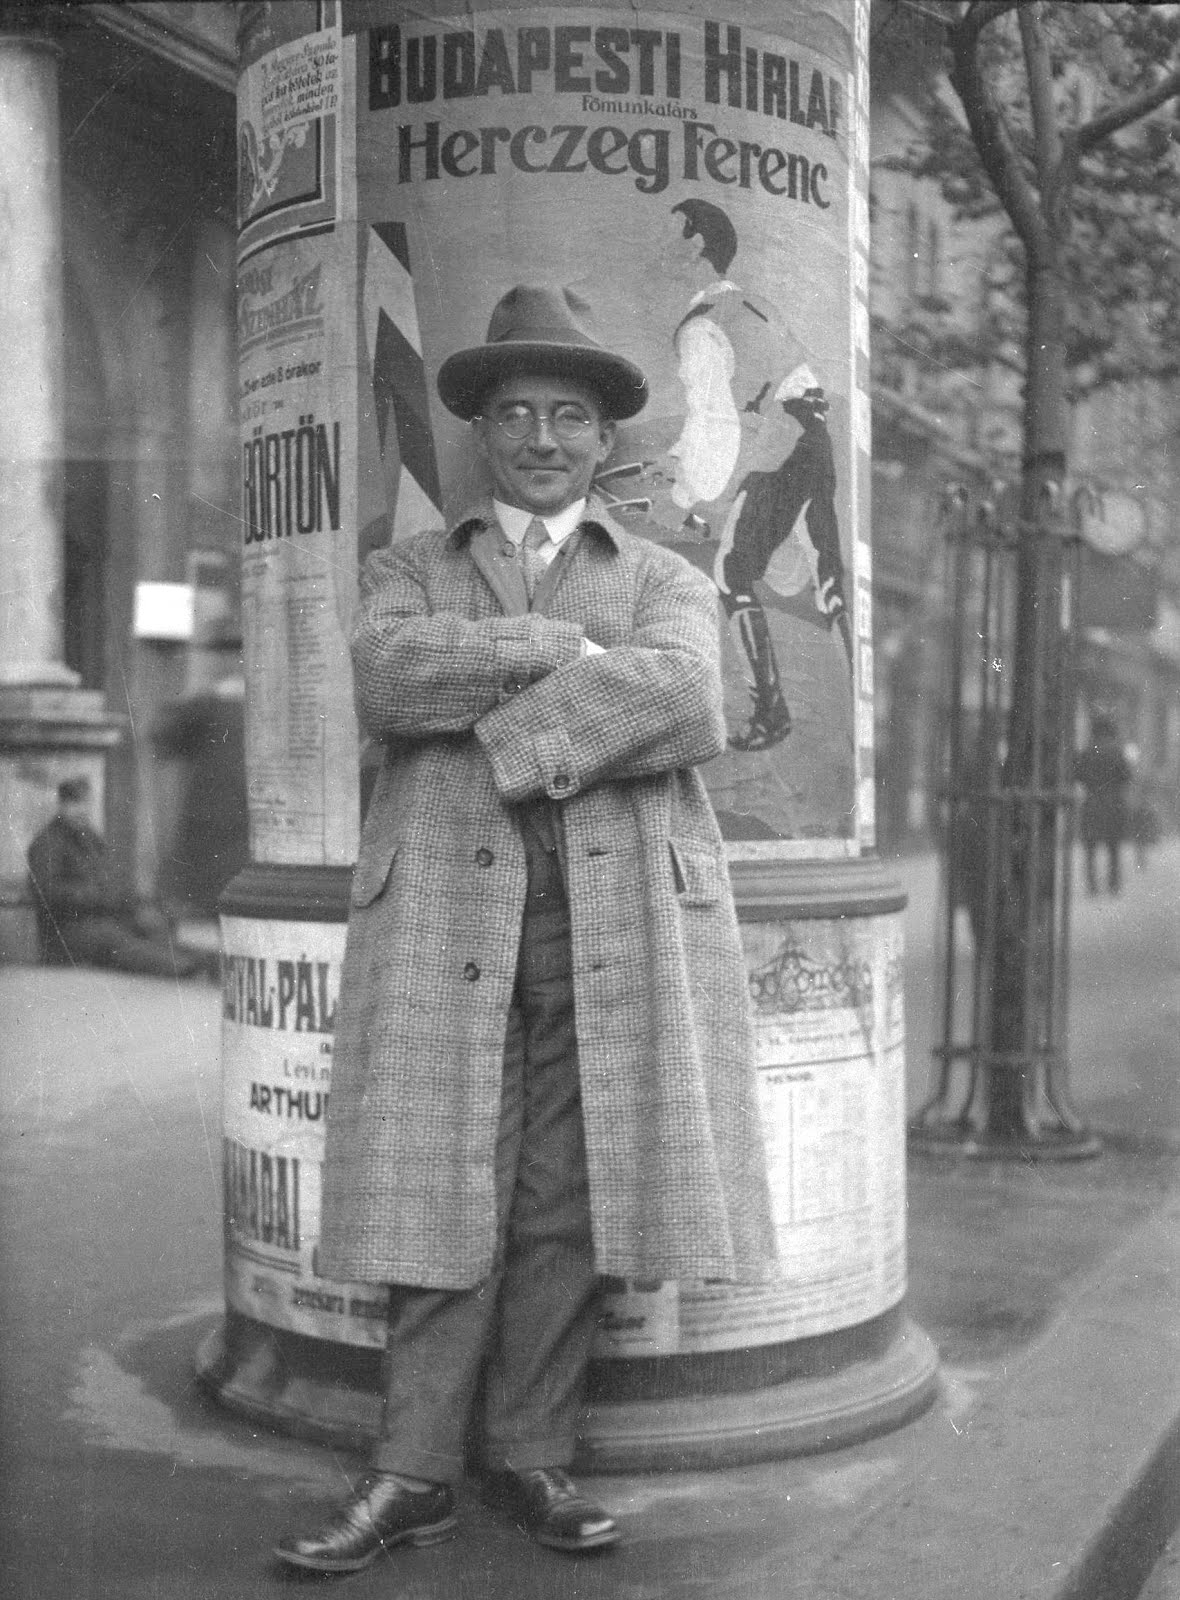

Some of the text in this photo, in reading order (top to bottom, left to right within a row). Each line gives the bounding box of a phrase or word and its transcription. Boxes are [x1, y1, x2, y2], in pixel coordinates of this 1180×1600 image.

[368, 24, 681, 112] BUDAPESTI
[398, 120, 831, 209] Herczeg Ferenc
